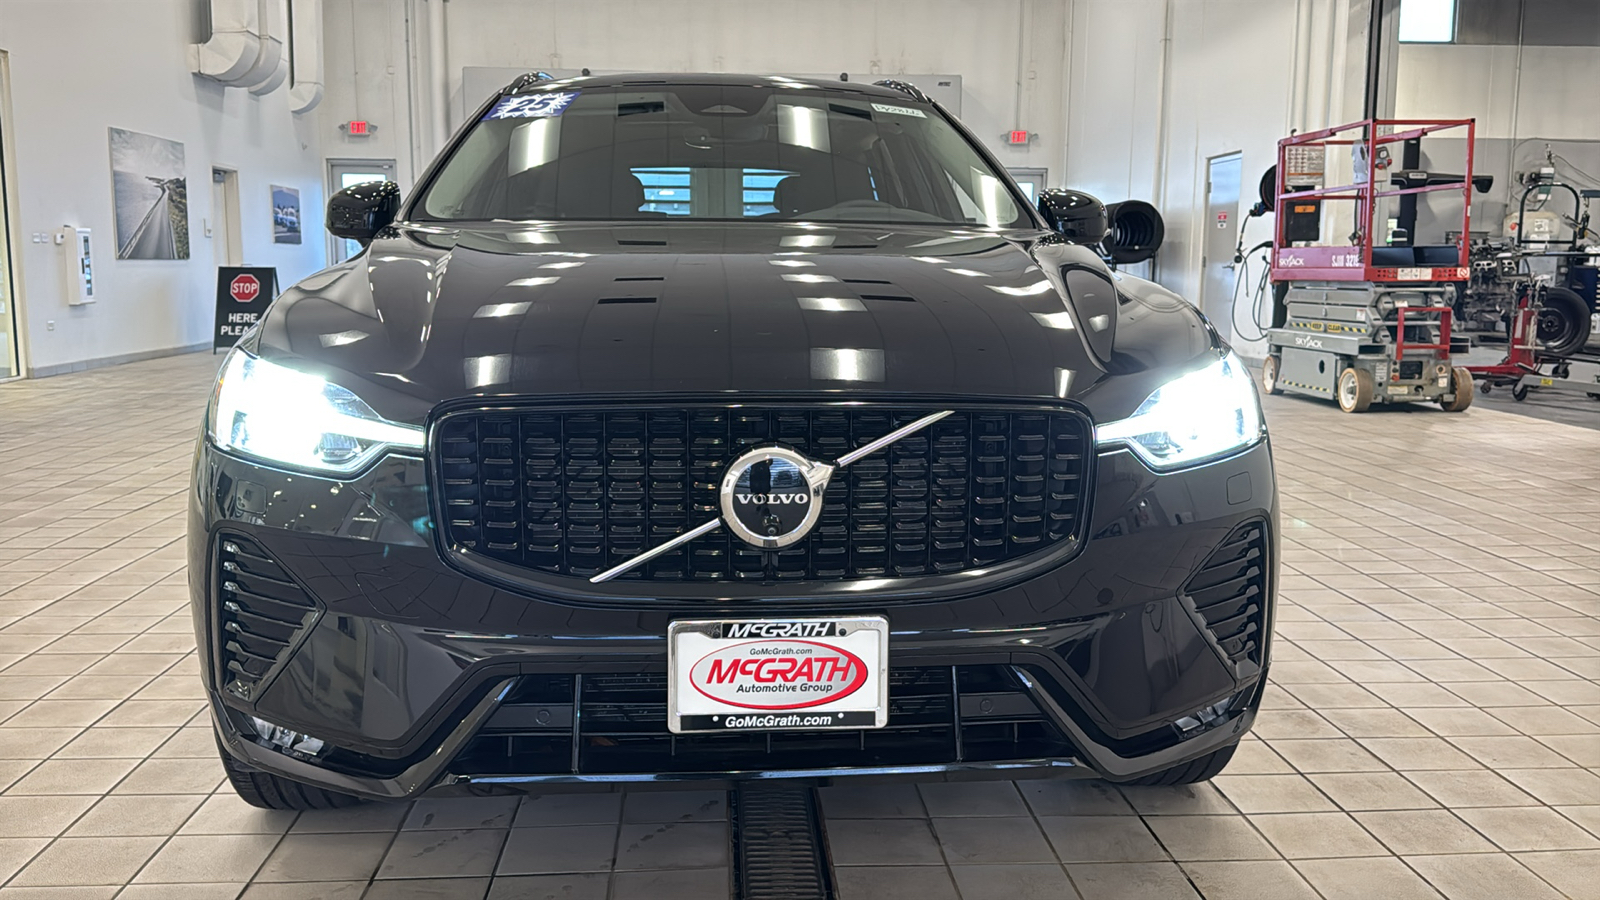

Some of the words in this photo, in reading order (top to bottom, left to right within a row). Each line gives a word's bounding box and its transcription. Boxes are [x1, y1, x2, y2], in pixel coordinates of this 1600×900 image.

[505, 97, 557, 113] 25
[350, 121, 366, 133] EXIT
[1011, 131, 1027, 143] EXIT
[1279, 255, 1304, 267] SKYJACK
[232, 283, 258, 294] STOP
[228, 313, 258, 323] HERE
[220, 325, 249, 335] PLEA
[1295, 336, 1322, 349] SKYJACK
[736, 493, 808, 505] VOLVO
[749, 647, 813, 656] GoMcGrath.com
[736, 683, 798, 693] Automotive
[800, 682, 833, 693] Group
[724, 715, 832, 728] GoMcGrath.com
